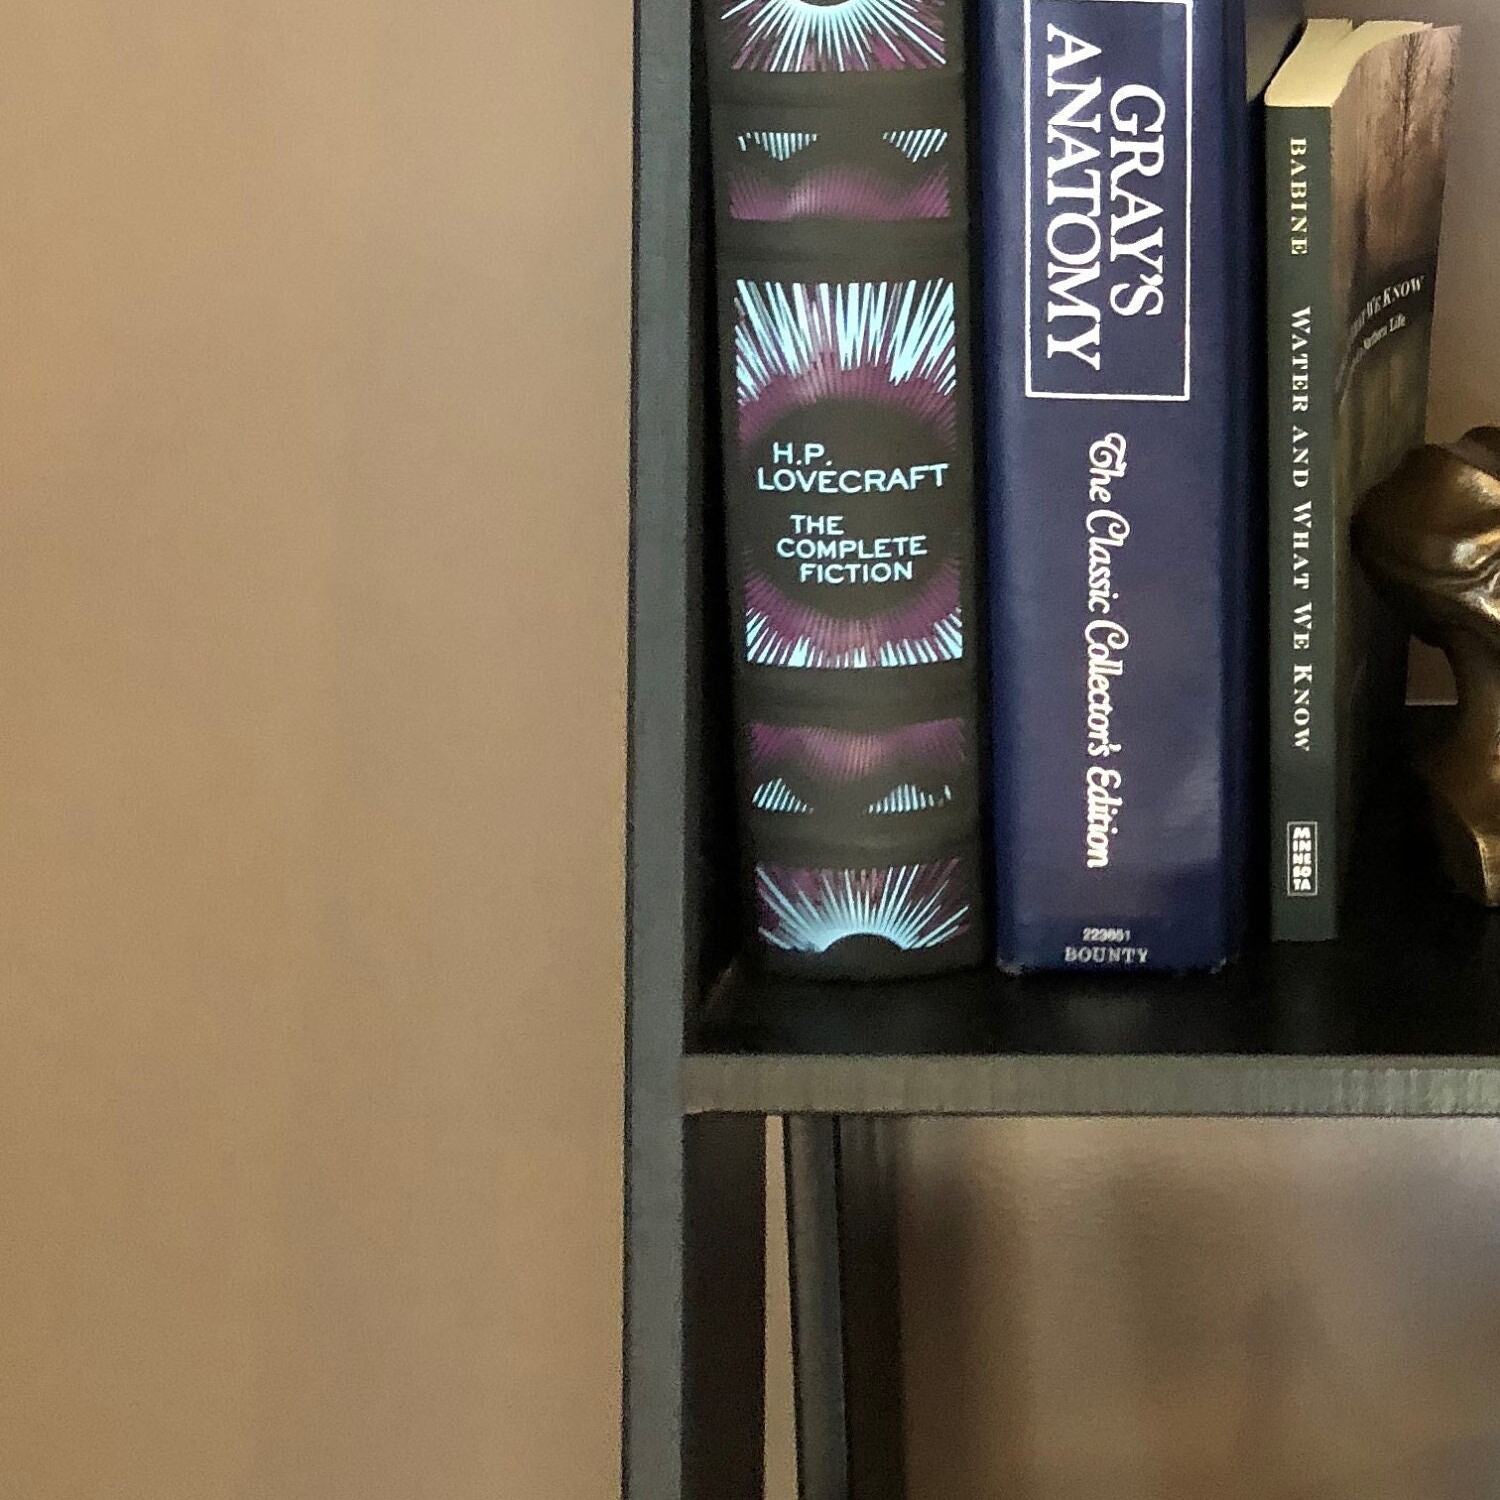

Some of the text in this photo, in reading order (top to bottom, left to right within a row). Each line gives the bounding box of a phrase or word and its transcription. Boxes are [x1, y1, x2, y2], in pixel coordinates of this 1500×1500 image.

[1046, 22, 1102, 371] ANATOMY
[1109, 83, 1166, 316] GRAY'S
[1290, 137, 1308, 255] BABINE
[1382, 275, 1425, 308] KNOW
[772, 441, 833, 467] H.P.
[757, 463, 949, 494] LOVECRAFT
[789, 514, 845, 536] THE
[1291, 306, 1313, 752] WATER AND WHAT WE KNOW
[776, 534, 928, 560] COMPLETE
[799, 560, 913, 584] FICTION
[1084, 432, 1131, 869] The Classic Collector's Edition
[1064, 946, 1148, 964] BOUNTY
